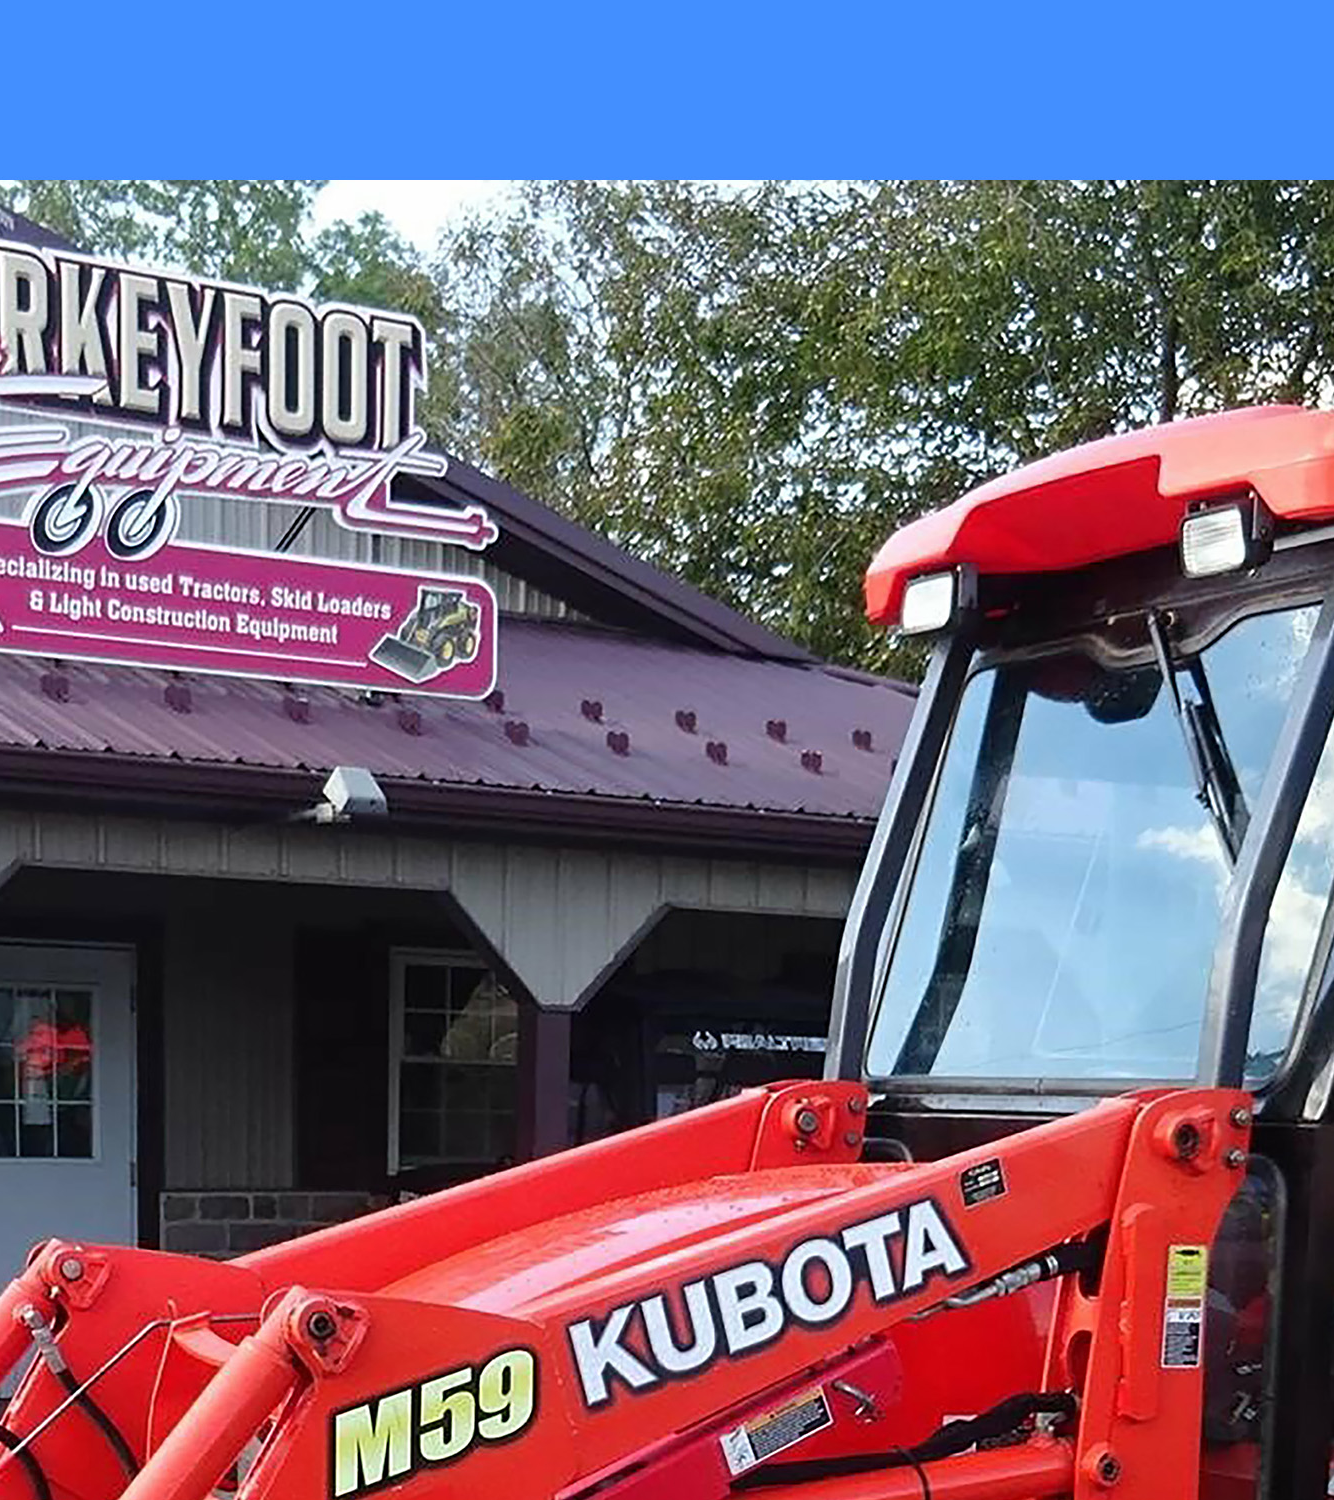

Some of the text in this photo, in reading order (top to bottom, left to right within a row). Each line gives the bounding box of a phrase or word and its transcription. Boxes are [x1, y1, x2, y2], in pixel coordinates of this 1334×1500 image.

[29, 589, 339, 645] & Light Construction Equipment
[100, 565, 121, 588] in
[124, 573, 174, 595] used
[270, 586, 313, 611] Skid
[317, 592, 392, 620] Loaders
[567, 1199, 968, 1407] KUBOTA
[331, 1347, 538, 1500] M59
